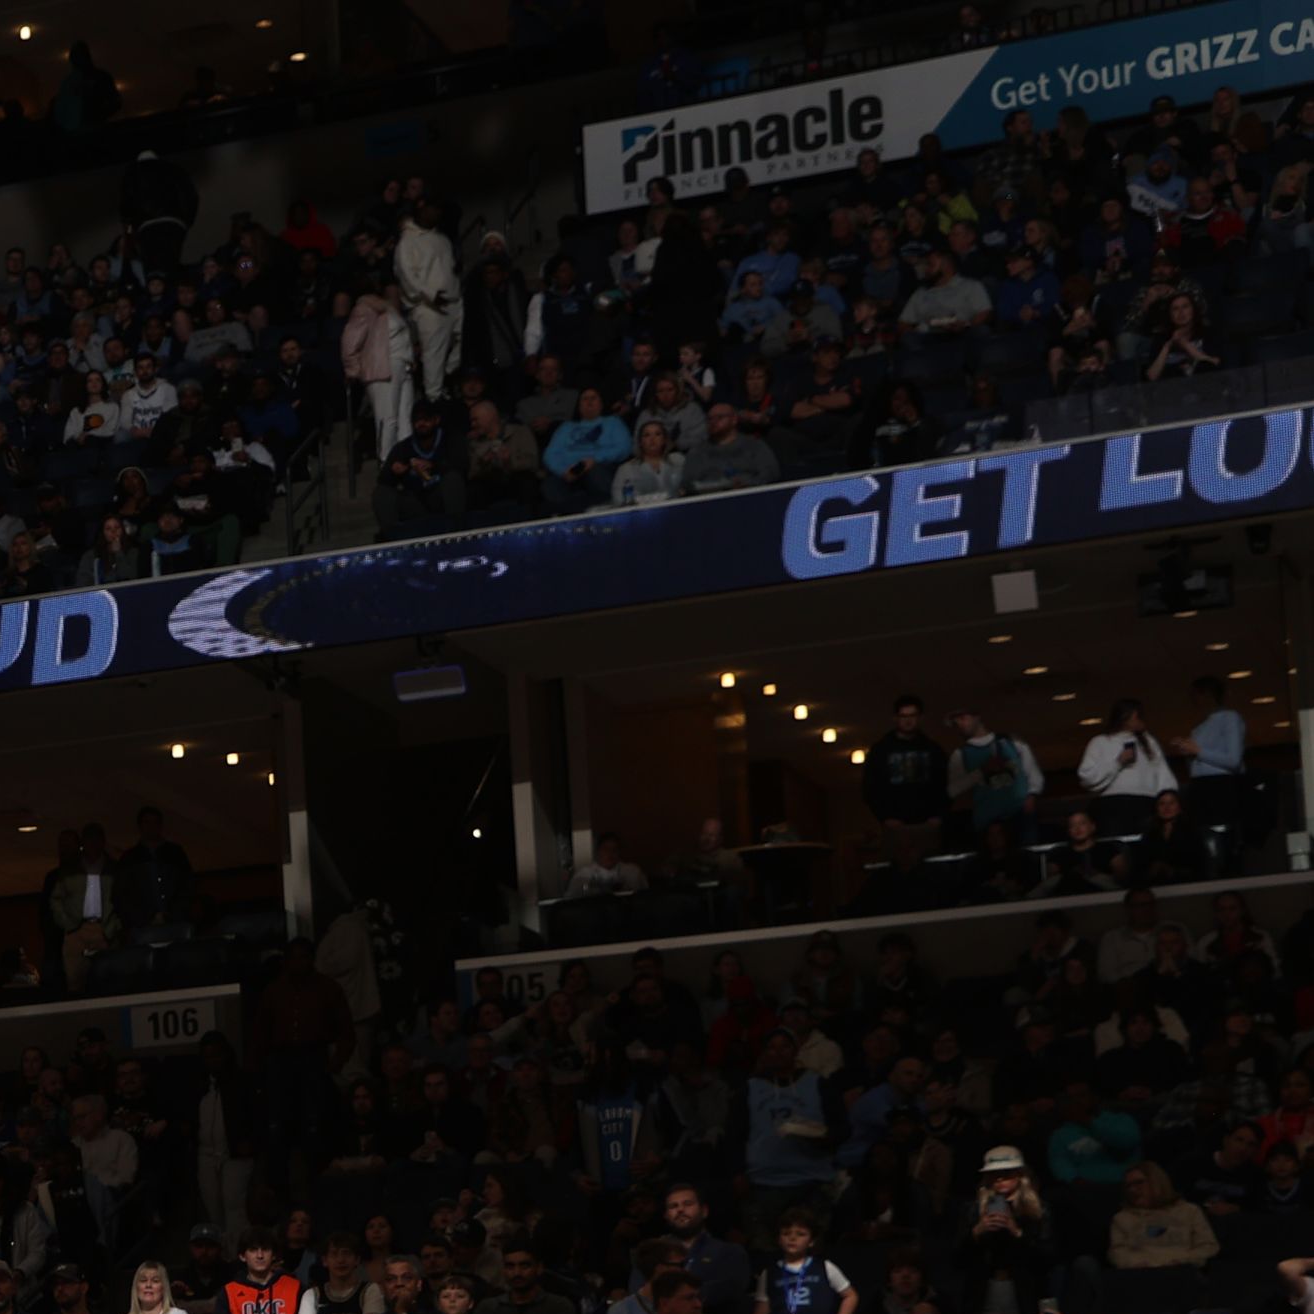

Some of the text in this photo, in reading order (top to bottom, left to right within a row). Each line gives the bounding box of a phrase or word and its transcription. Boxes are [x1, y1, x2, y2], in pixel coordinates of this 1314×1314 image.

[990, 73, 1051, 110] Get
[1058, 61, 1136, 97] Your
[1145, 28, 1260, 80] GRIZZ
[622, 88, 884, 184] Pinnacle
[781, 408, 1314, 581] GET LO
[507, 972, 544, 1004] 05
[147, 1006, 199, 1041] 106
[610, 1140, 622, 1162] 0
